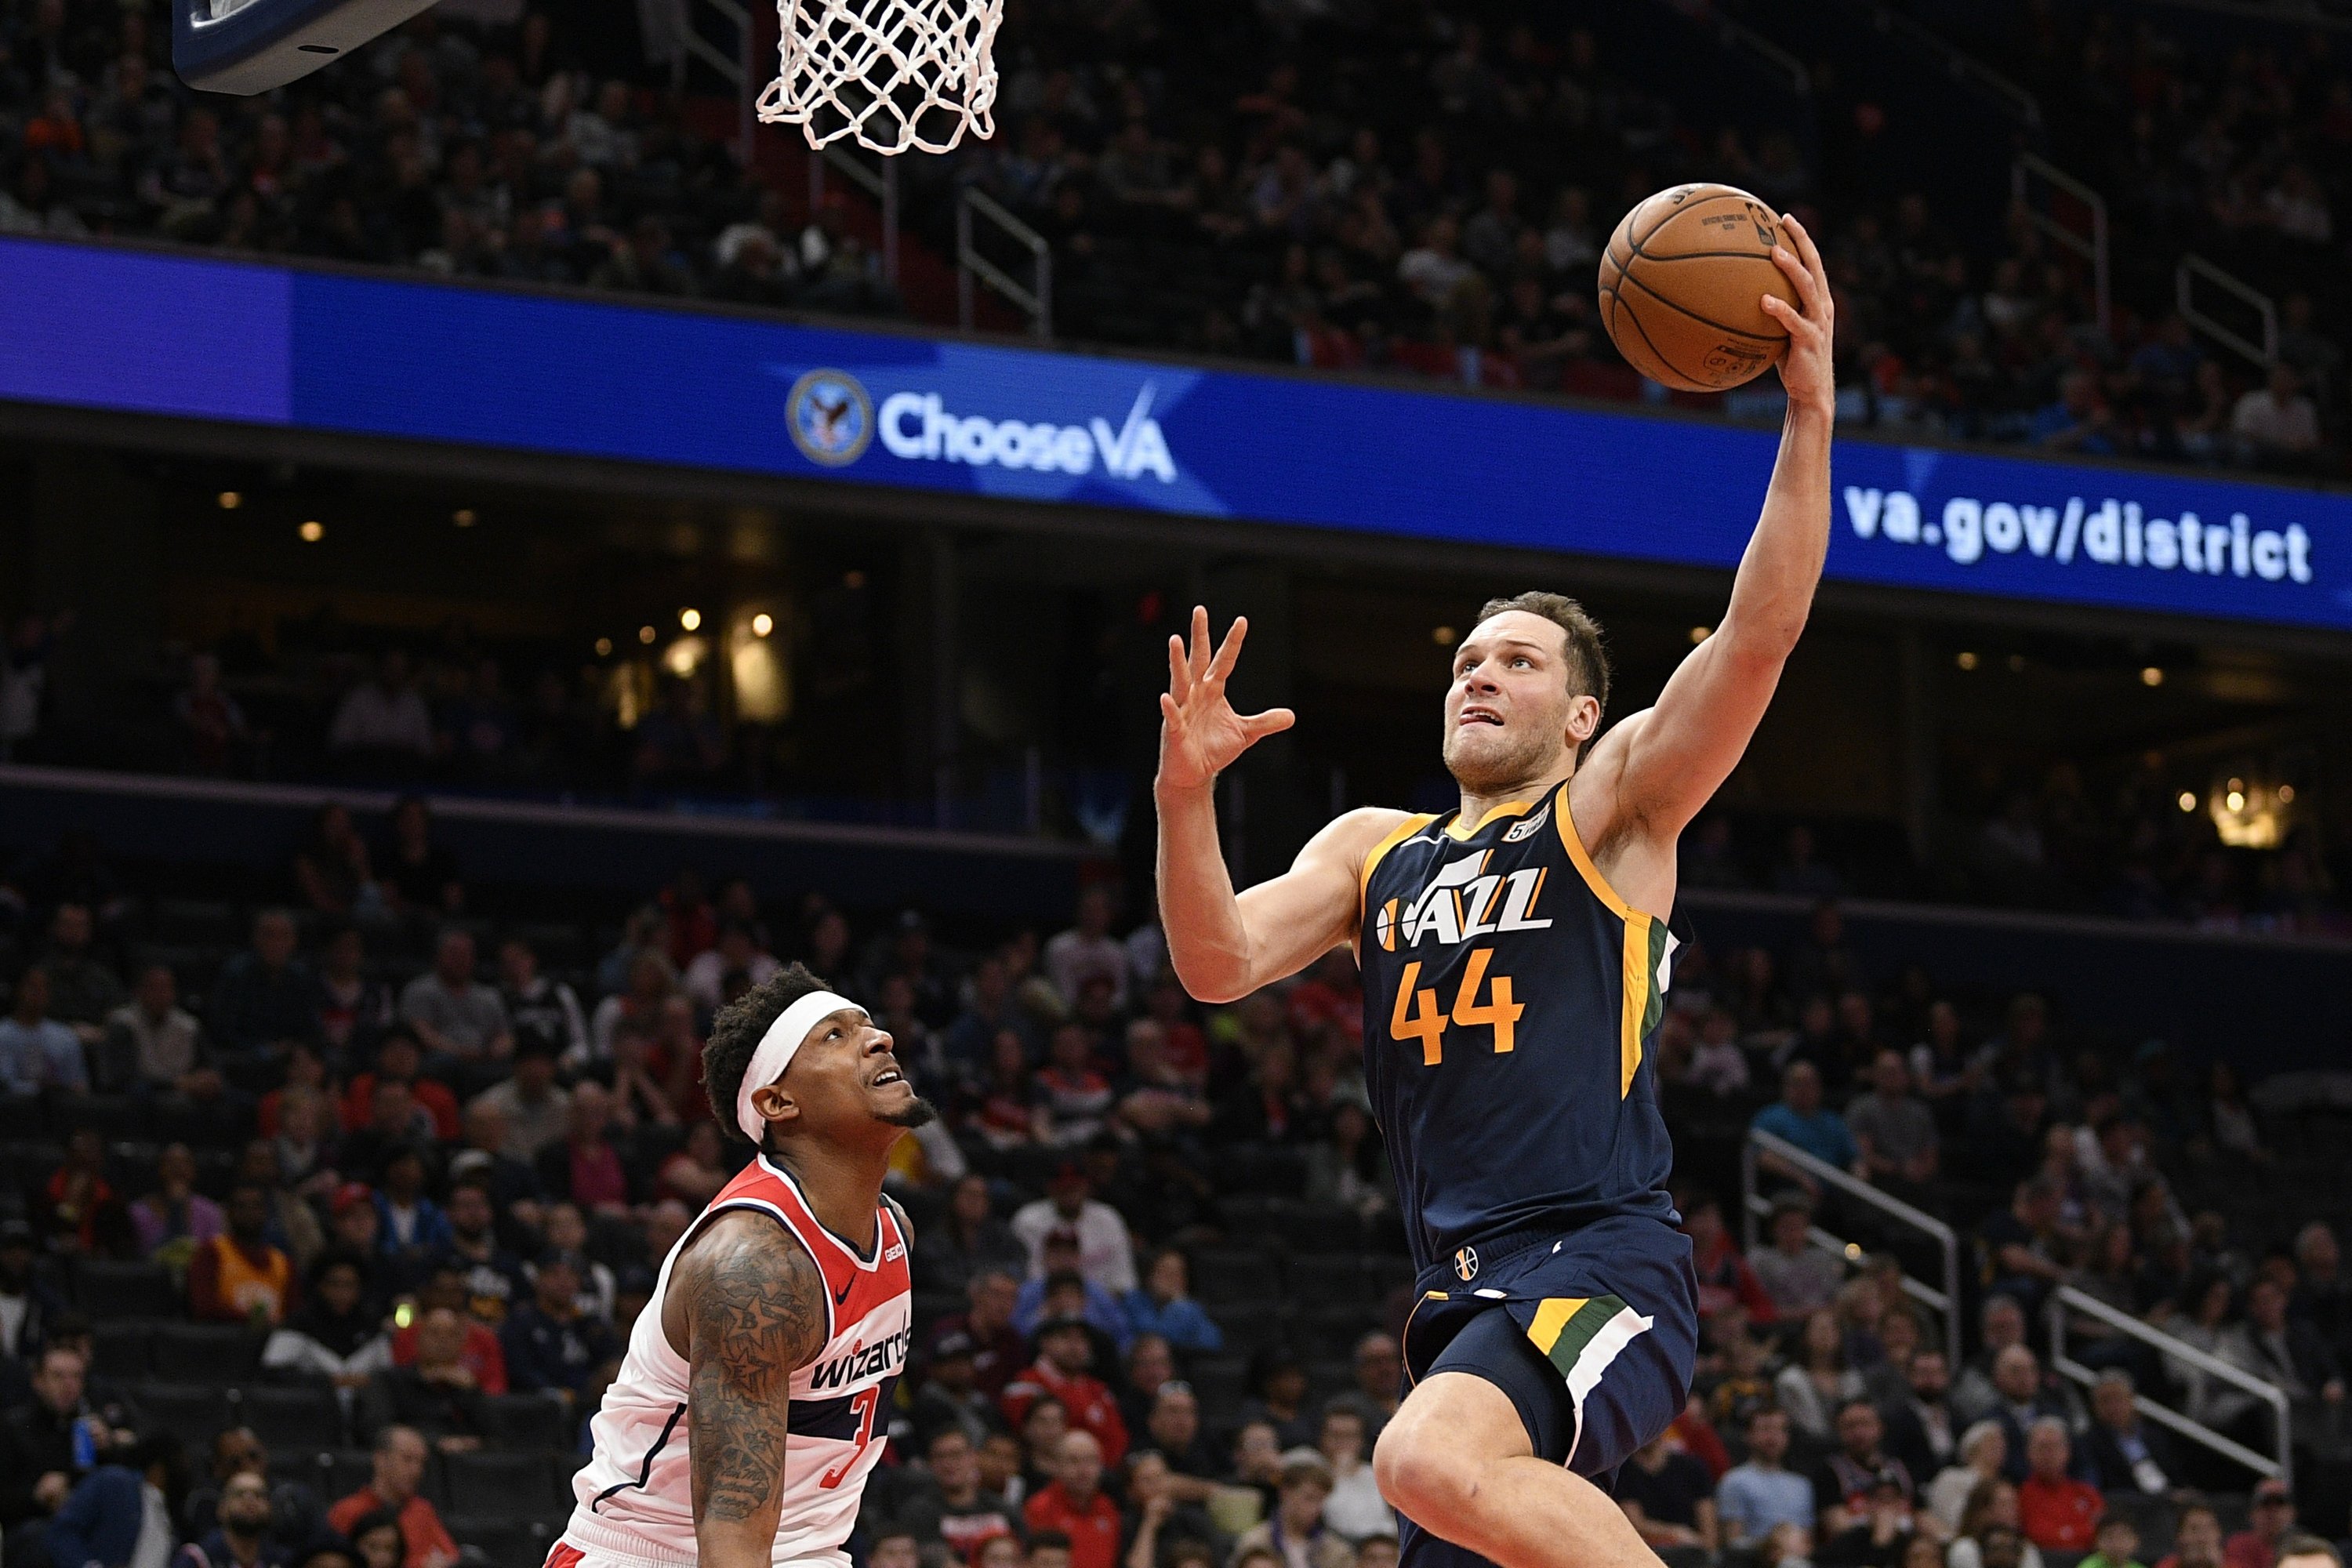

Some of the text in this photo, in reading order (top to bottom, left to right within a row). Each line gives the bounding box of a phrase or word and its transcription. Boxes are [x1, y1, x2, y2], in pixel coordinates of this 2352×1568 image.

[1842, 485, 2314, 585] va.gov/district
[1377, 848, 1553, 948] JAZZ
[1390, 948, 1526, 1066] 44
[818, 1385, 879, 1490] 3
